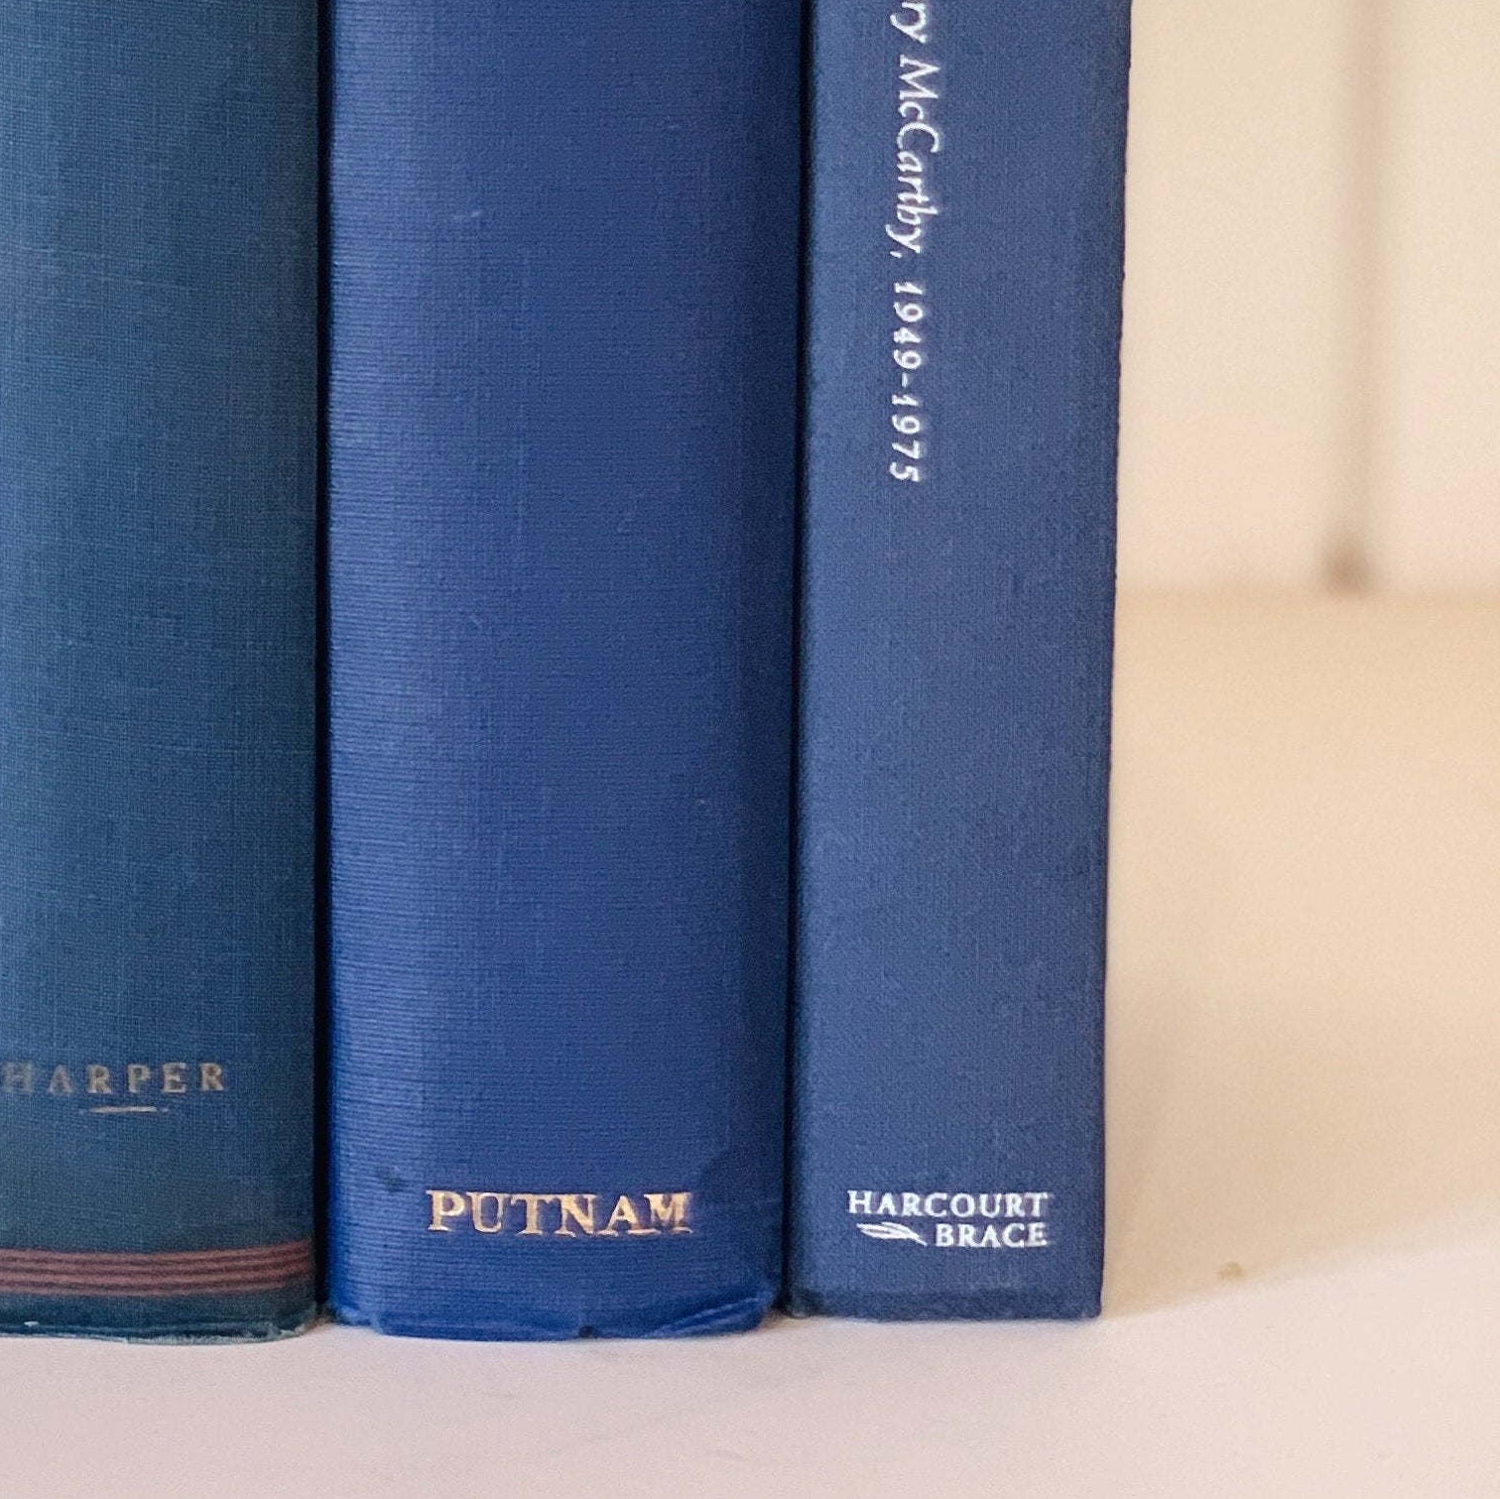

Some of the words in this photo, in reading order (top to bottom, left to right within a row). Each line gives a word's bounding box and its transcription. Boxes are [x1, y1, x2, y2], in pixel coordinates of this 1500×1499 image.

[885, 55, 940, 259] McCarthy,
[889, 282, 924, 482] 1949-1975
[0, 1062, 224, 1093] HARPER
[425, 1189, 692, 1238] PUTNAM
[847, 1189, 1051, 1217] HARCOURT
[935, 1222, 1048, 1248] BRACE
